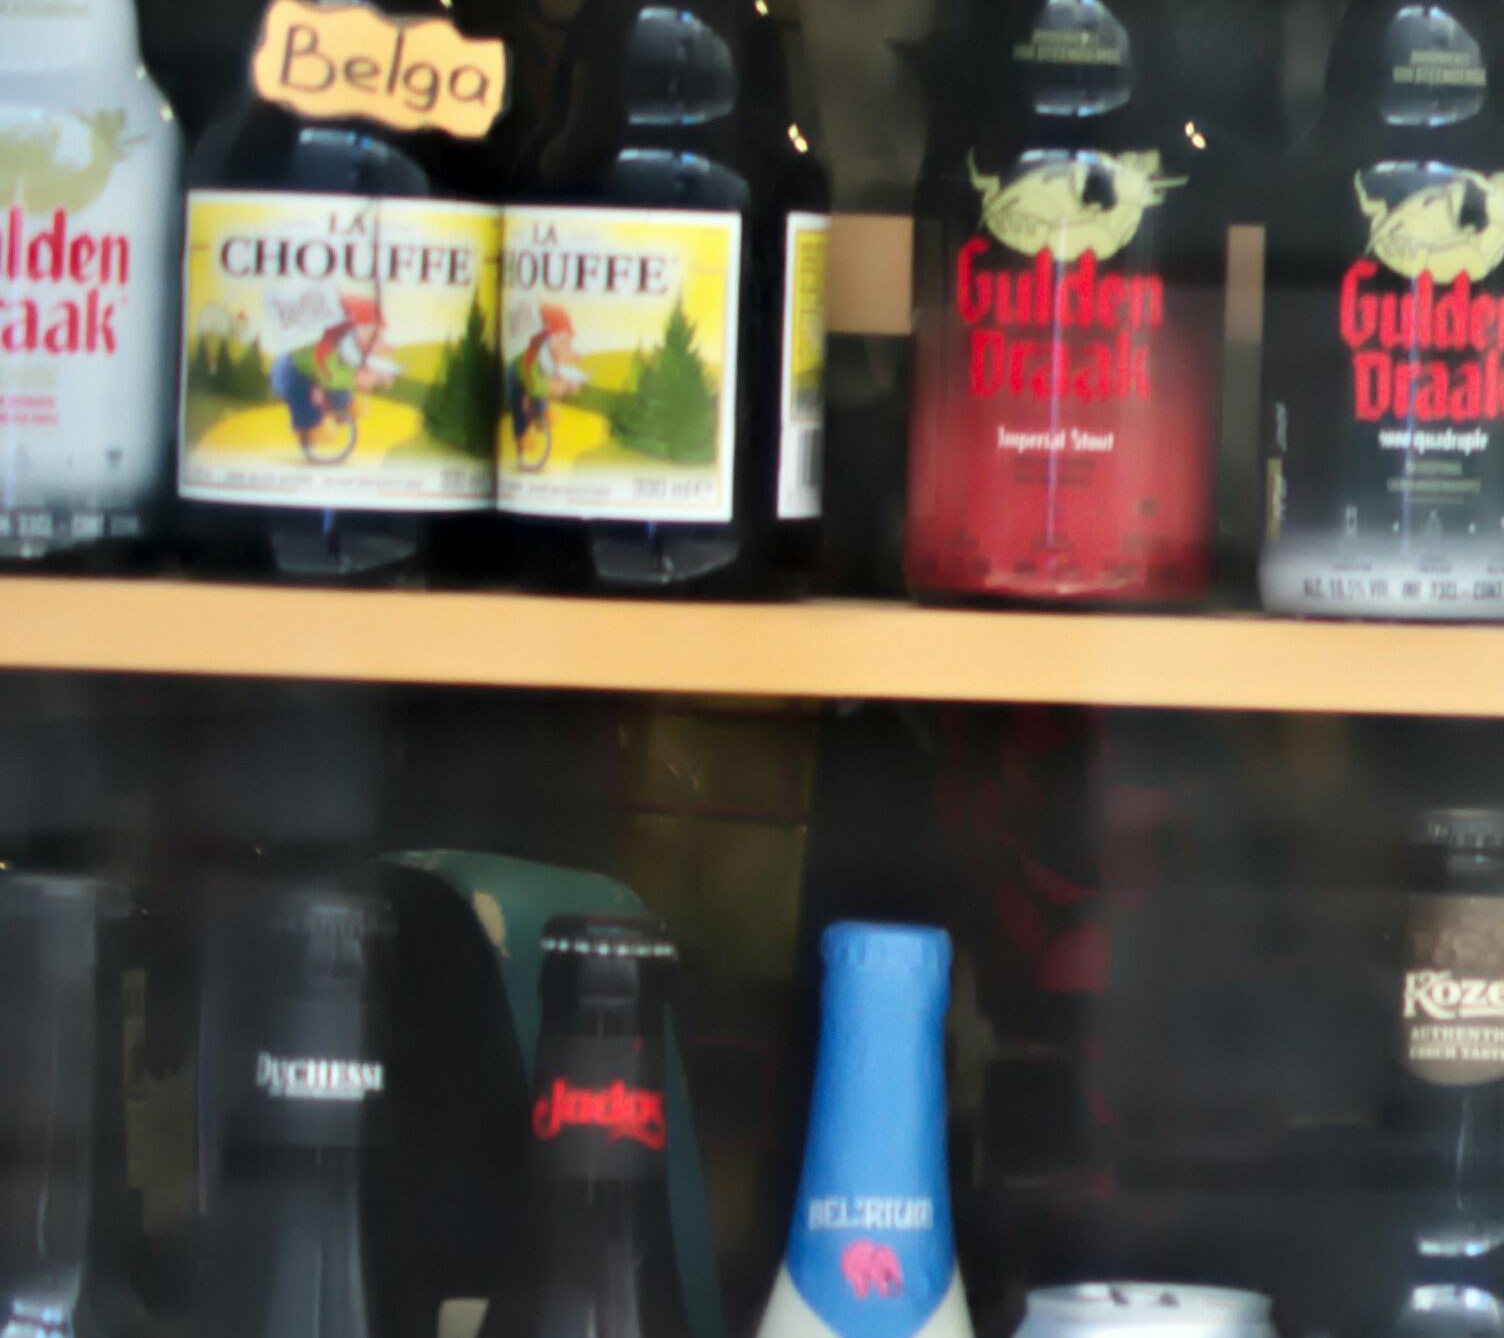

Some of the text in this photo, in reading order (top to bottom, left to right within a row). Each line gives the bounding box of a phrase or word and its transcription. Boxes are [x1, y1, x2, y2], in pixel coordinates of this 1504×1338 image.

[279, 23, 490, 112] Belga
[0, 207, 130, 288] lden
[328, 212, 370, 237] LA
[531, 221, 558, 245] LA
[220, 235, 473, 287] CHOUFFE
[955, 236, 1165, 332] Gulden
[969, 328, 1153, 404] Draak
[997, 424, 1115, 454] Imperial Stout
